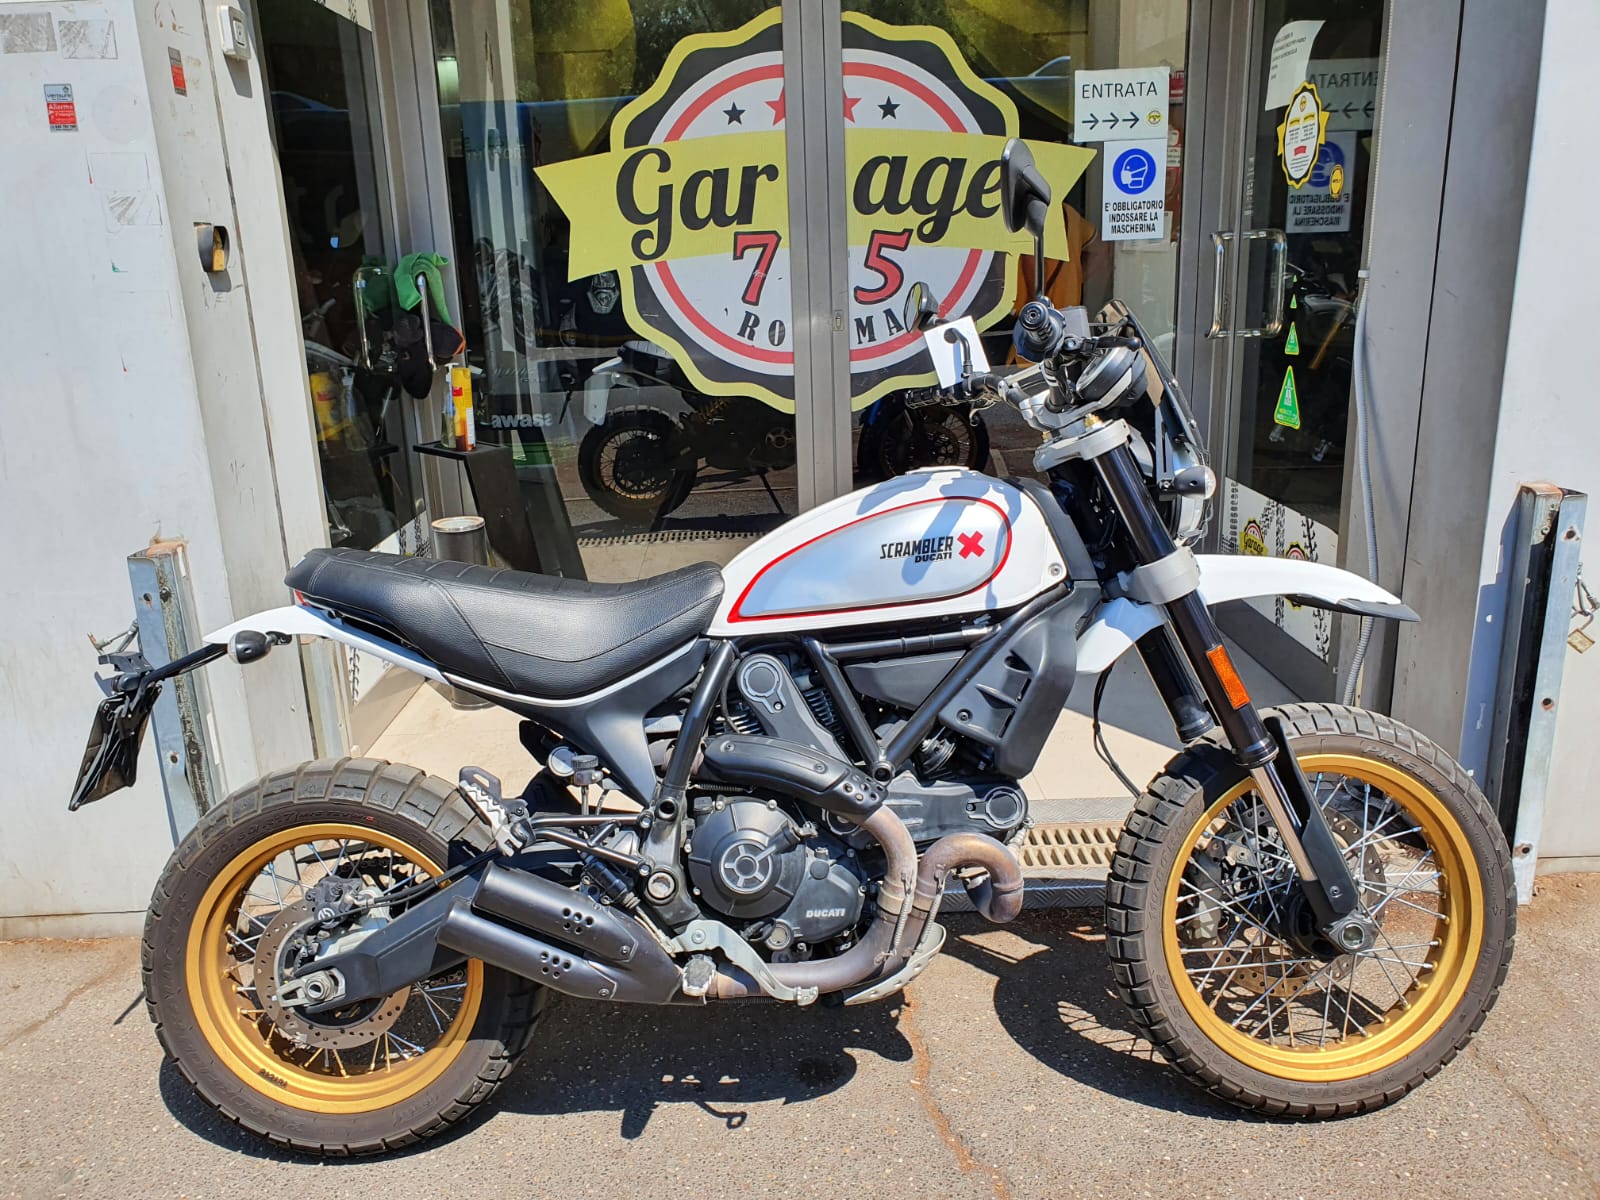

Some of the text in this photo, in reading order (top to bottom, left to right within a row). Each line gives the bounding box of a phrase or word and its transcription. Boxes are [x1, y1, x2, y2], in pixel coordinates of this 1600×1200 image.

[1082, 81, 1158, 98] ENTRATA
[1112, 200, 1164, 211] OBBLIGATORIO
[1109, 212, 1158, 223] INDOSSARE LA
[1111, 223, 1156, 234] MASCHERINA
[880, 535, 954, 559] SCRAMBLER
[914, 552, 953, 563] DUCATI
[1362, 745, 1448, 793] PIRELLI
[805, 907, 846, 918] DUCATI
